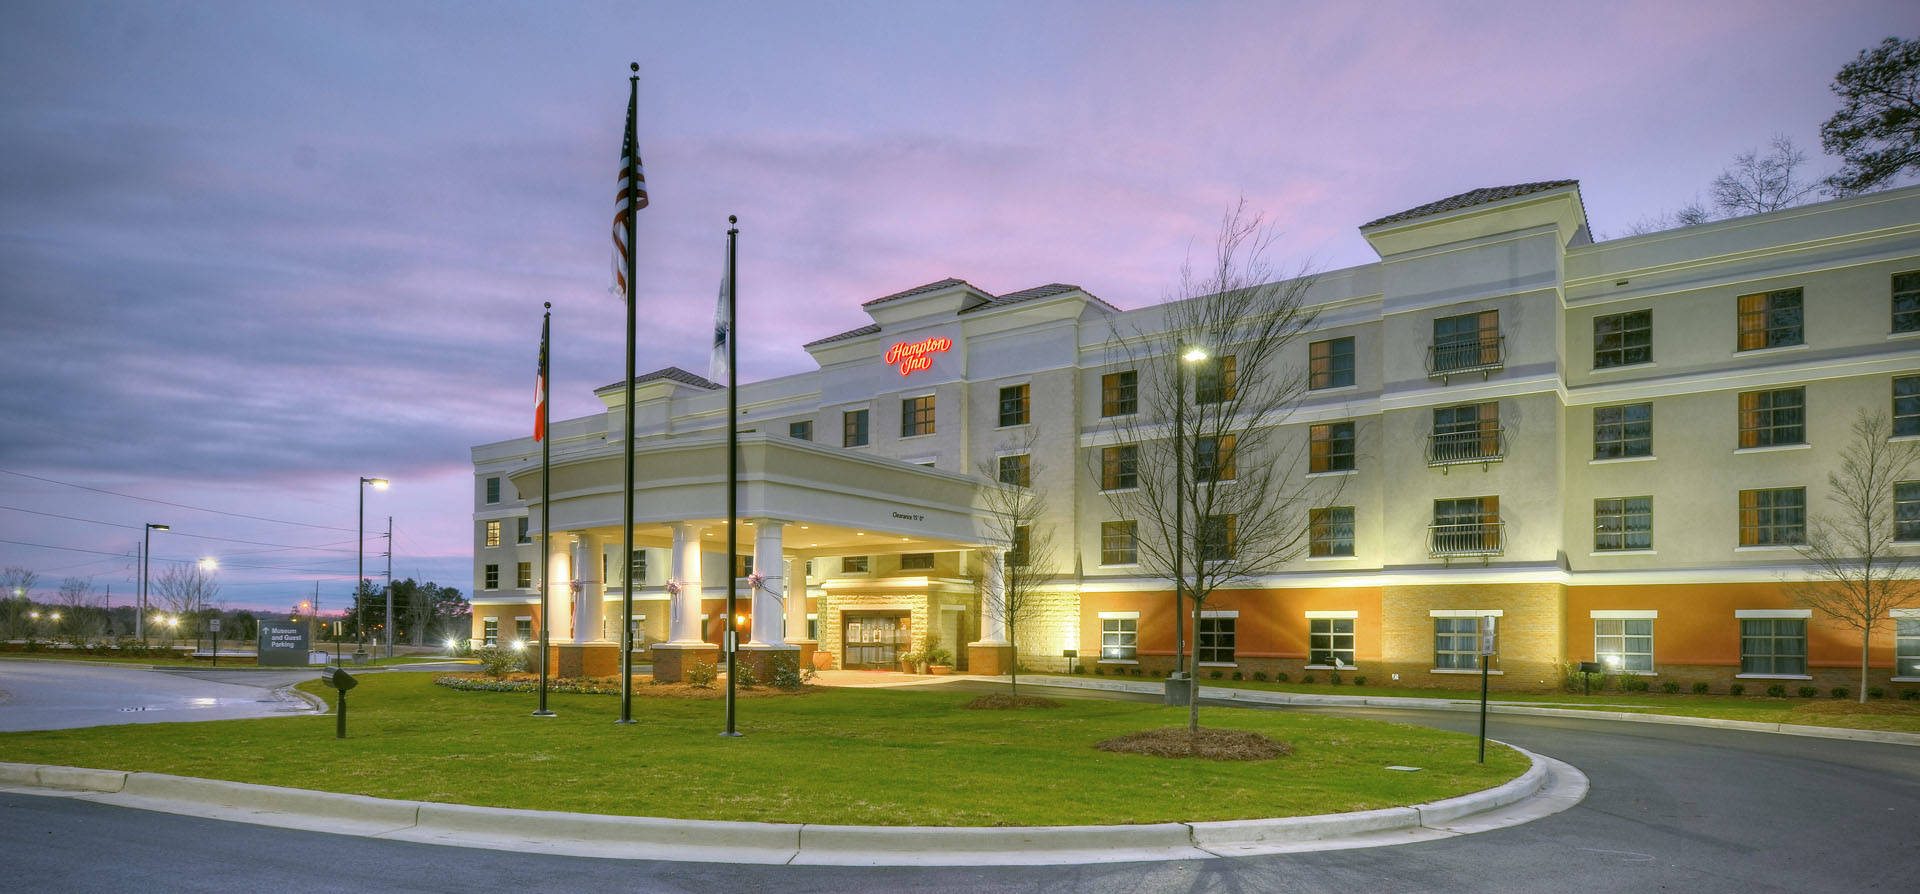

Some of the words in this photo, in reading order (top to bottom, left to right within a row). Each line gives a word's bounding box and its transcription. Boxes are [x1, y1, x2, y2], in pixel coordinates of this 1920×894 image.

[885, 337, 952, 364] Hampton
[900, 354, 933, 376] Inn
[892, 511, 912, 520] Clearance
[271, 641, 294, 649] Parking
